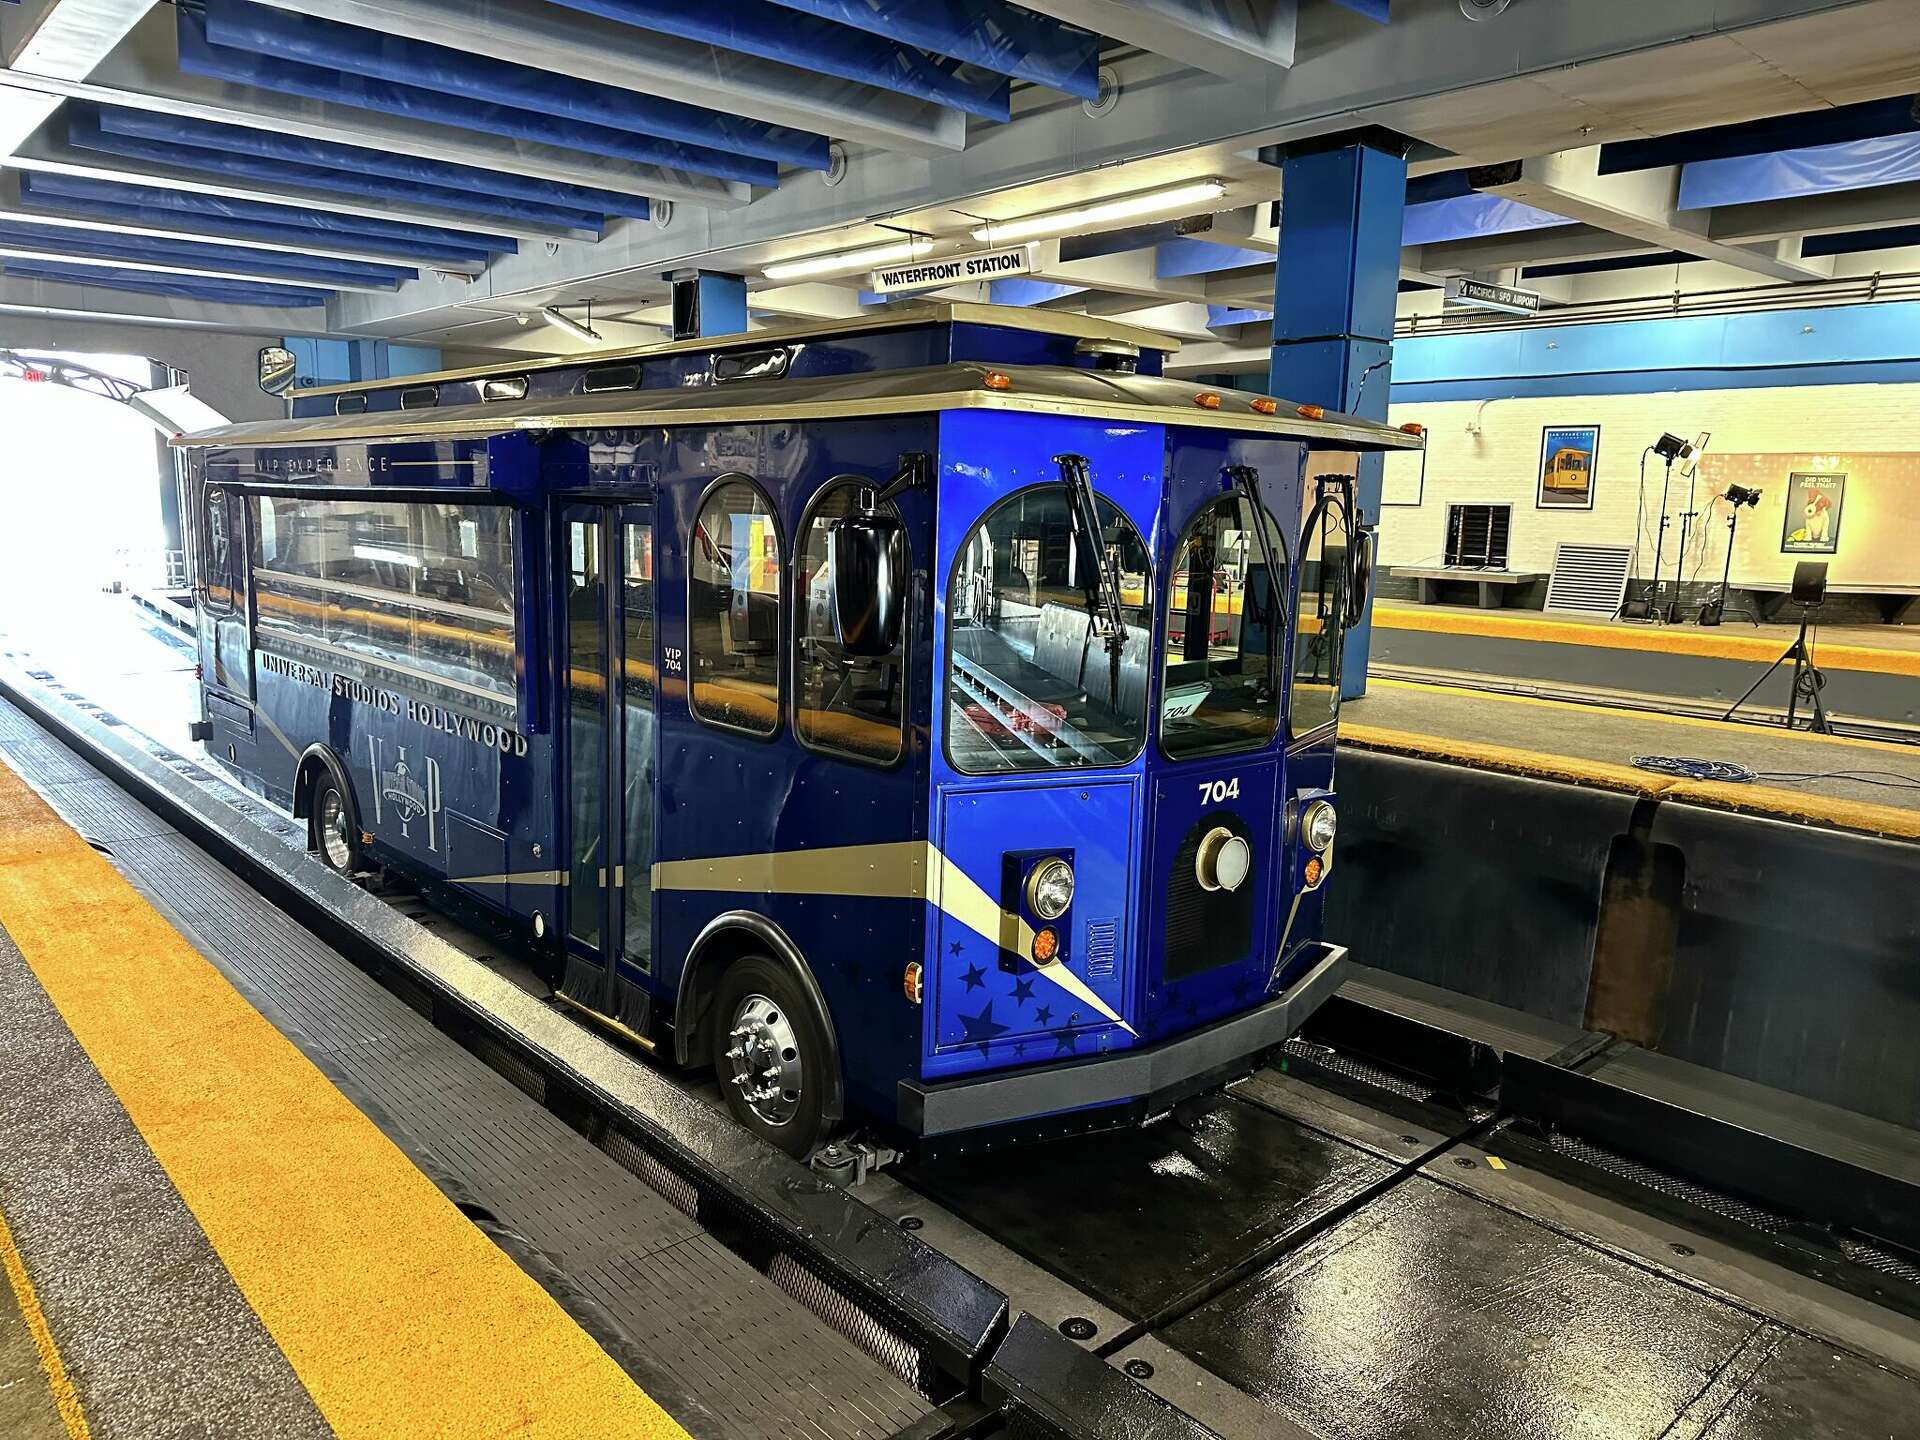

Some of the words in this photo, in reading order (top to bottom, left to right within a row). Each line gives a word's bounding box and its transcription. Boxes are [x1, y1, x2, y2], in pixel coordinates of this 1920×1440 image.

[881, 262, 961, 287] WATERFRONT
[966, 253, 1021, 275] STATION
[1468, 285, 1496, 300] PACIFICA
[1499, 291, 1511, 303] SFO
[1512, 294, 1537, 308] AIRPORT
[257, 459, 279, 472] VIP
[288, 457, 388, 472] EXPERENCE
[664, 647, 682, 660] VIP
[664, 658, 682, 672] 704
[262, 652, 331, 692] UNIVERSAL
[334, 676, 400, 716] STUDIOS
[406, 699, 528, 758] HOLLYWOOD
[1164, 704, 1193, 719] 704
[1198, 777, 1240, 806] 704
